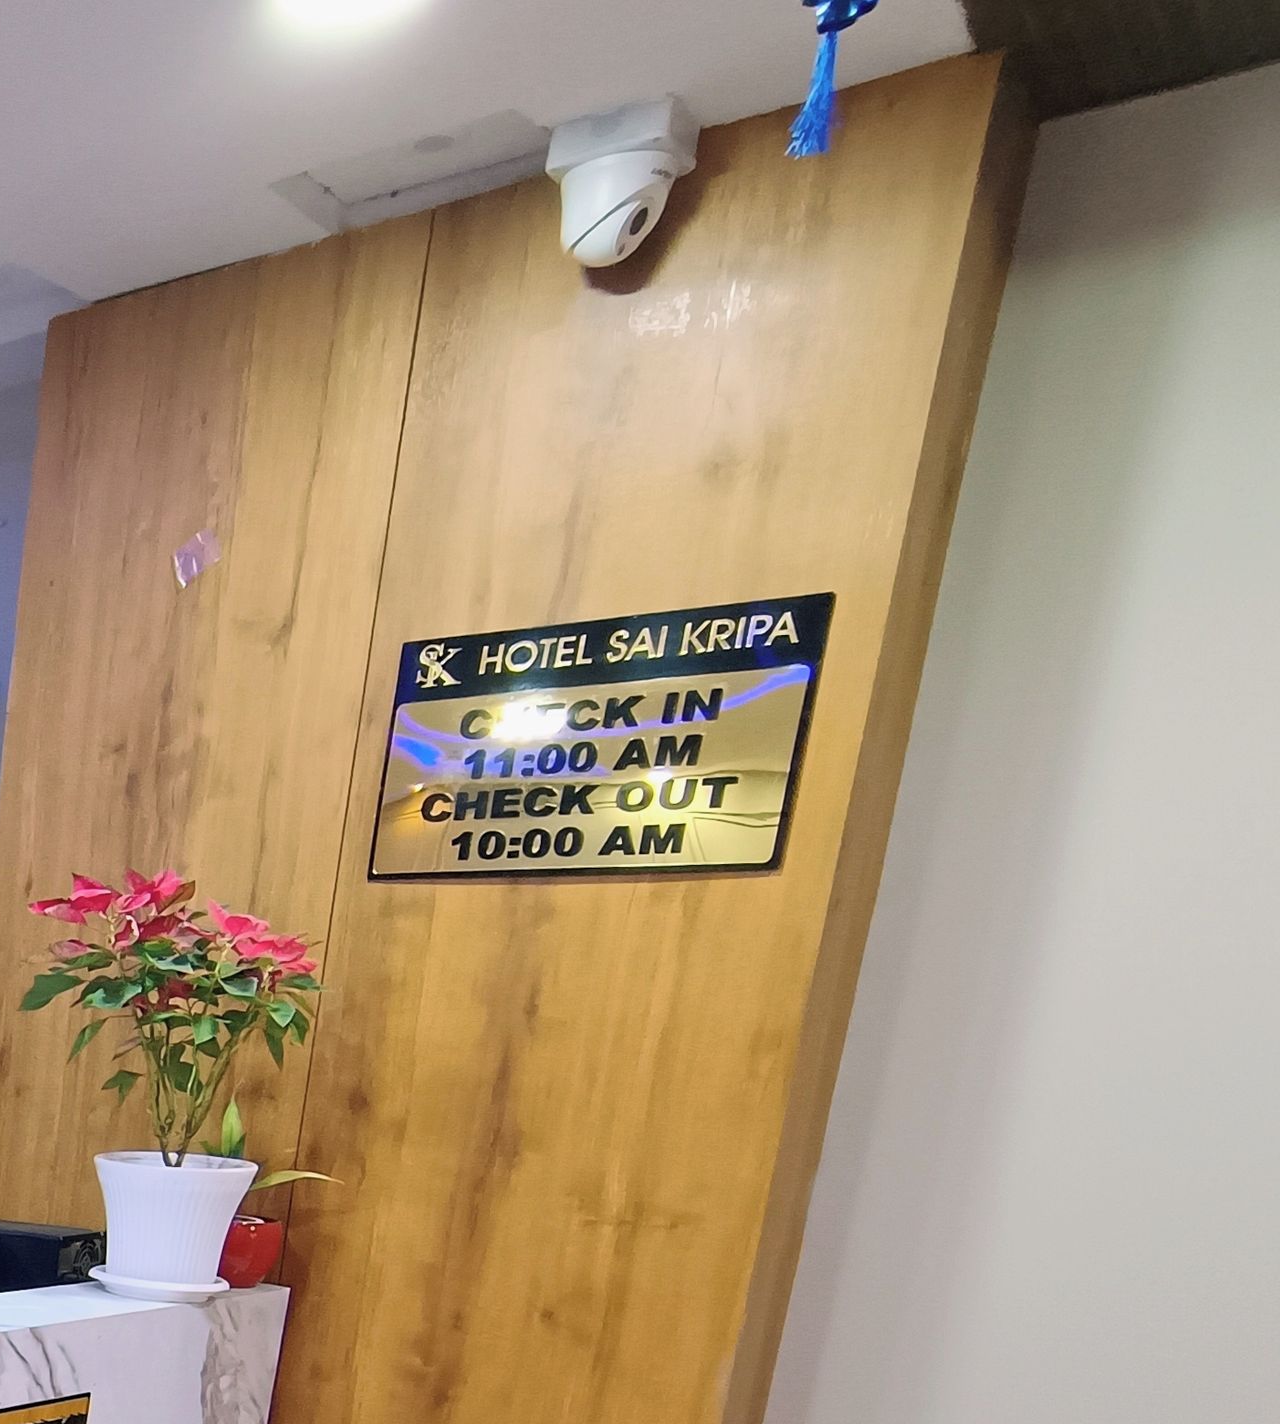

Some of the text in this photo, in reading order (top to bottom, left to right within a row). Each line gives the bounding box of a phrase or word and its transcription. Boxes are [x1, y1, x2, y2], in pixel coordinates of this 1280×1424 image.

[478, 611, 800, 676] HOTEL SAI KRIPA
[459, 687, 724, 741] CCK IN
[463, 733, 704, 780] 11:00 AM
[421, 775, 739, 824] CHECK OUT
[450, 823, 686, 861] 10:00 AM
